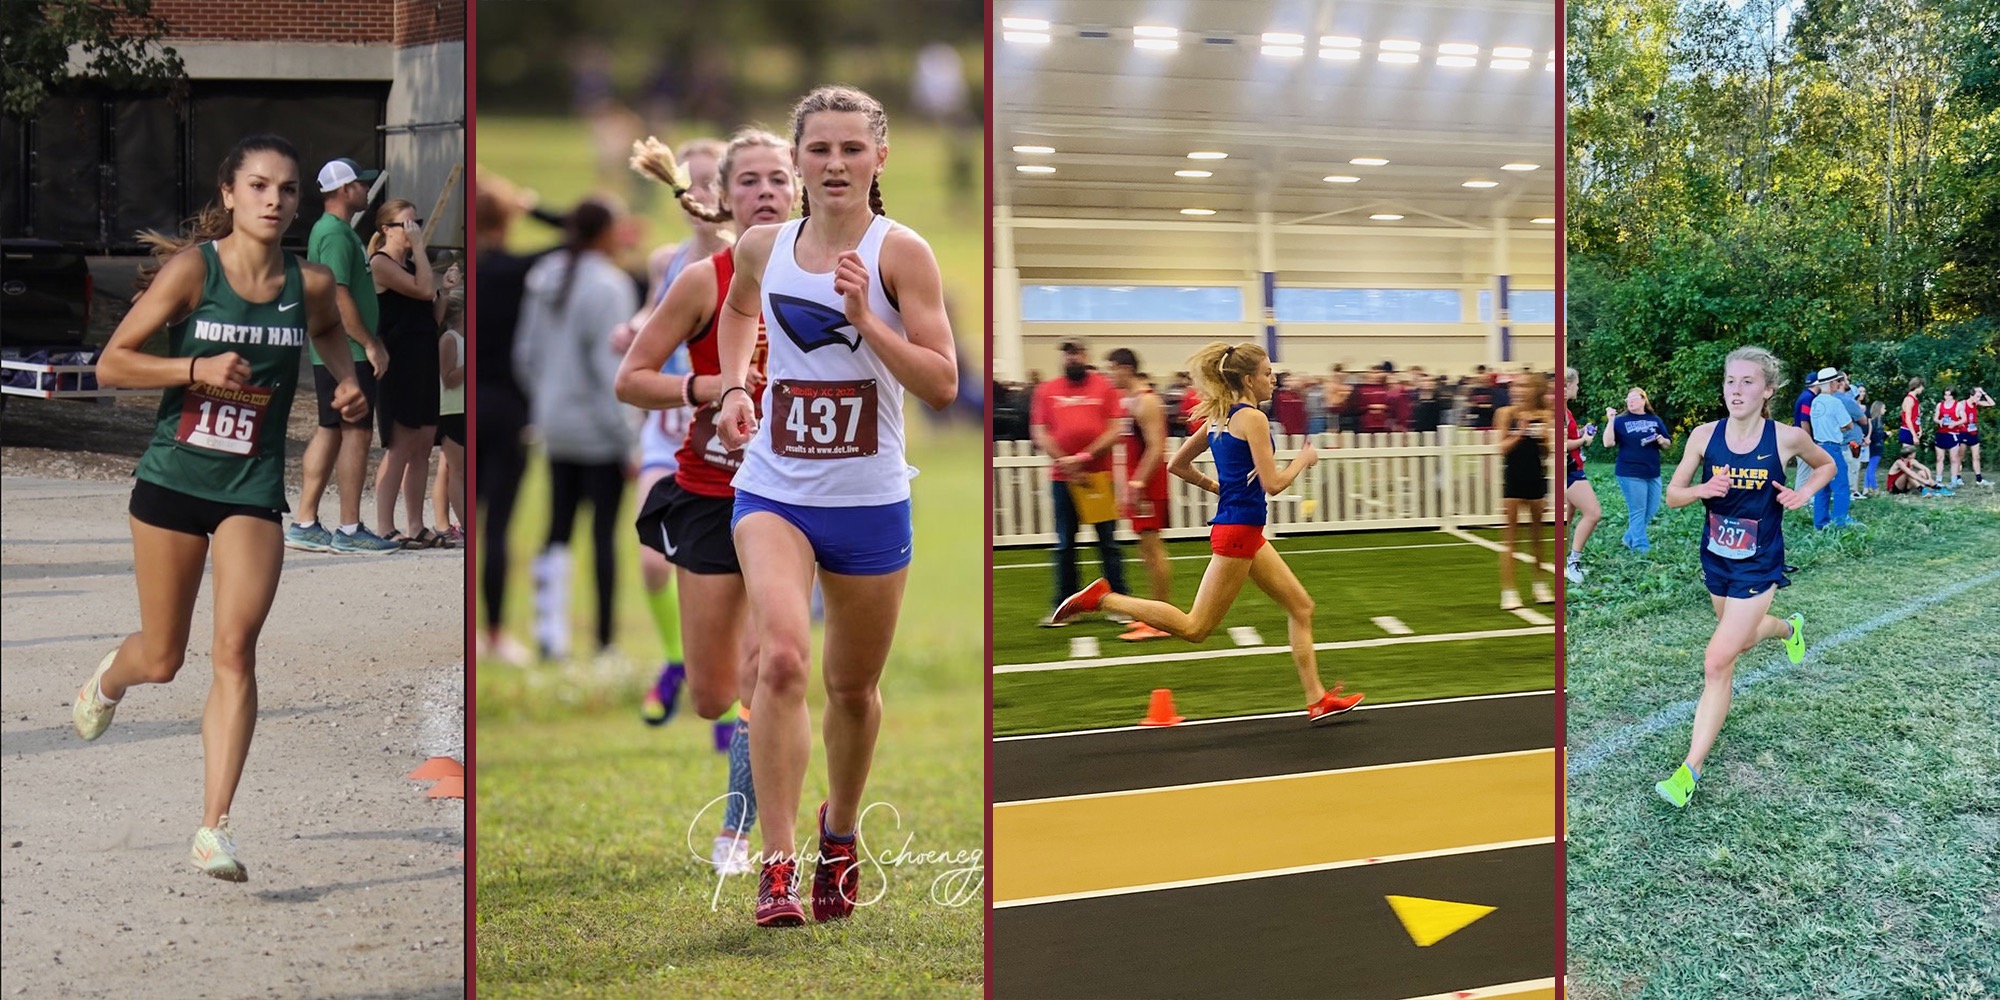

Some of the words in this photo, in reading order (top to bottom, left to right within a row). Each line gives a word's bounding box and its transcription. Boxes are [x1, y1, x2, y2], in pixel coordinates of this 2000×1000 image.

[194, 320, 263, 344] NORTH
[195, 400, 256, 441] 165
[785, 397, 863, 444] 437
[785, 445, 806, 454] results
[808, 446, 815, 454] at
[1729, 478, 1767, 490] LLEY
[1717, 524, 1746, 548] 237
